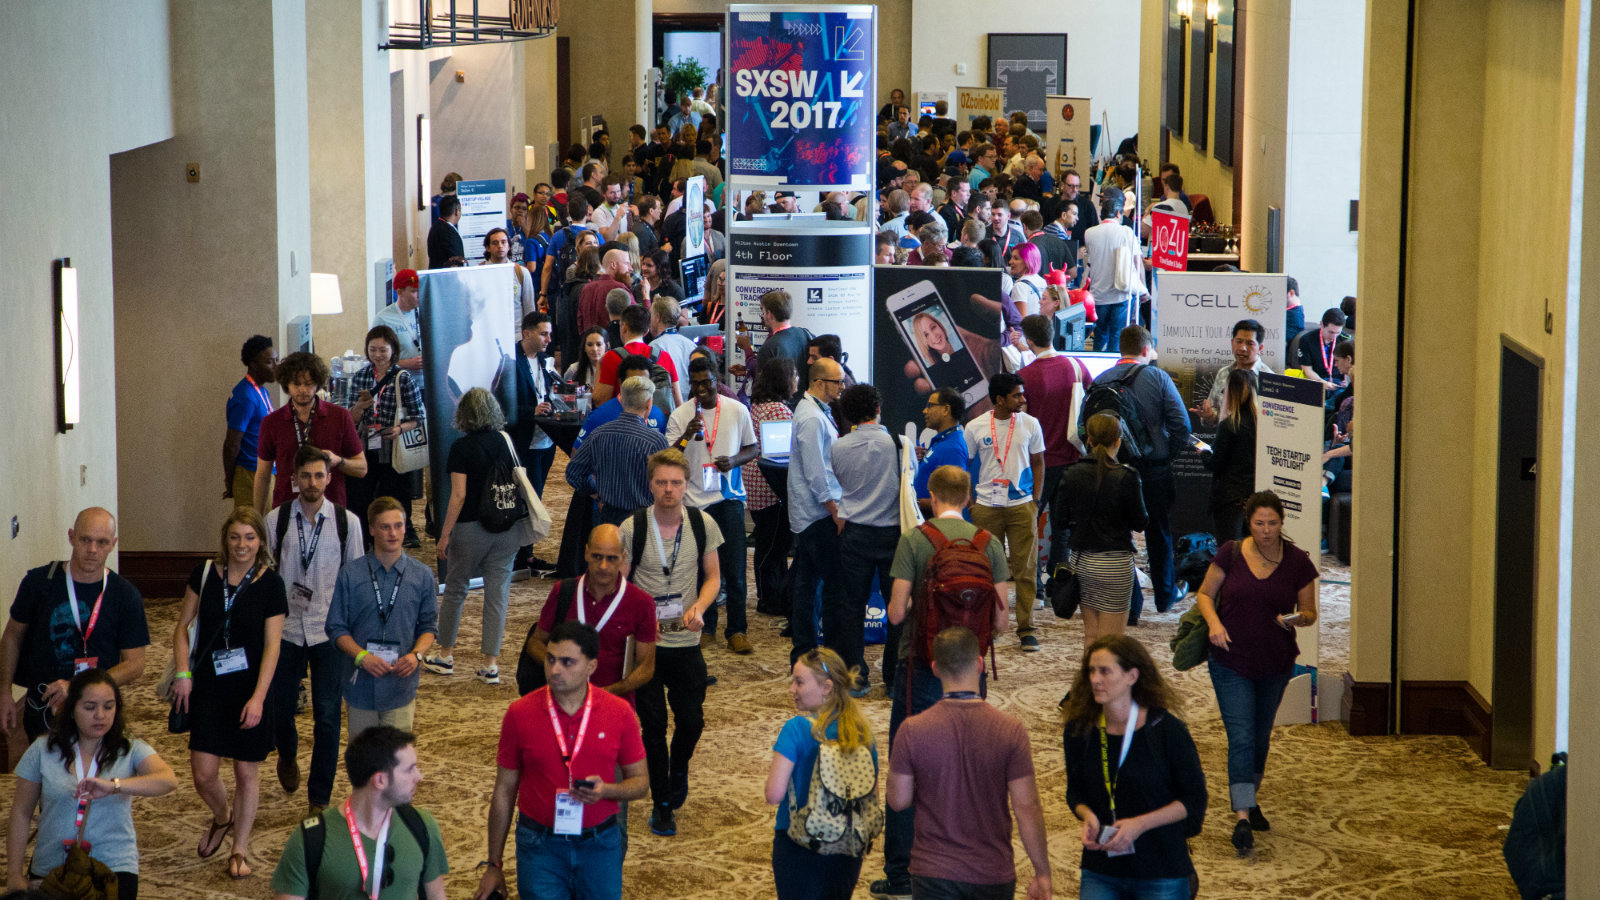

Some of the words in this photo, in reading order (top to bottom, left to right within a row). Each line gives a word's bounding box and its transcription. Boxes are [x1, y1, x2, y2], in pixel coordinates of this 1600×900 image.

[735, 68, 818, 98] SXSW
[960, 92, 1000, 110] OZcoinGold
[770, 101, 842, 129] 2017
[1153, 219, 1185, 257] JOZU
[735, 251, 753, 260] 4th
[759, 251, 793, 261] Floor
[1162, 324, 1203, 339] IMMUNIZE
[1205, 325, 1223, 339] YOUR
[1180, 347, 1199, 355] Time
[1201, 347, 1213, 355] for
[1265, 348, 1275, 357] to
[1181, 356, 1211, 364] Defend
[1262, 400, 1295, 414] CONVERGENCE
[1266, 445, 1282, 457] TECH
[1282, 448, 1311, 463] STARTUP
[1271, 456, 1305, 471] SPOTLIGHT
[496, 501, 516, 510] Club
